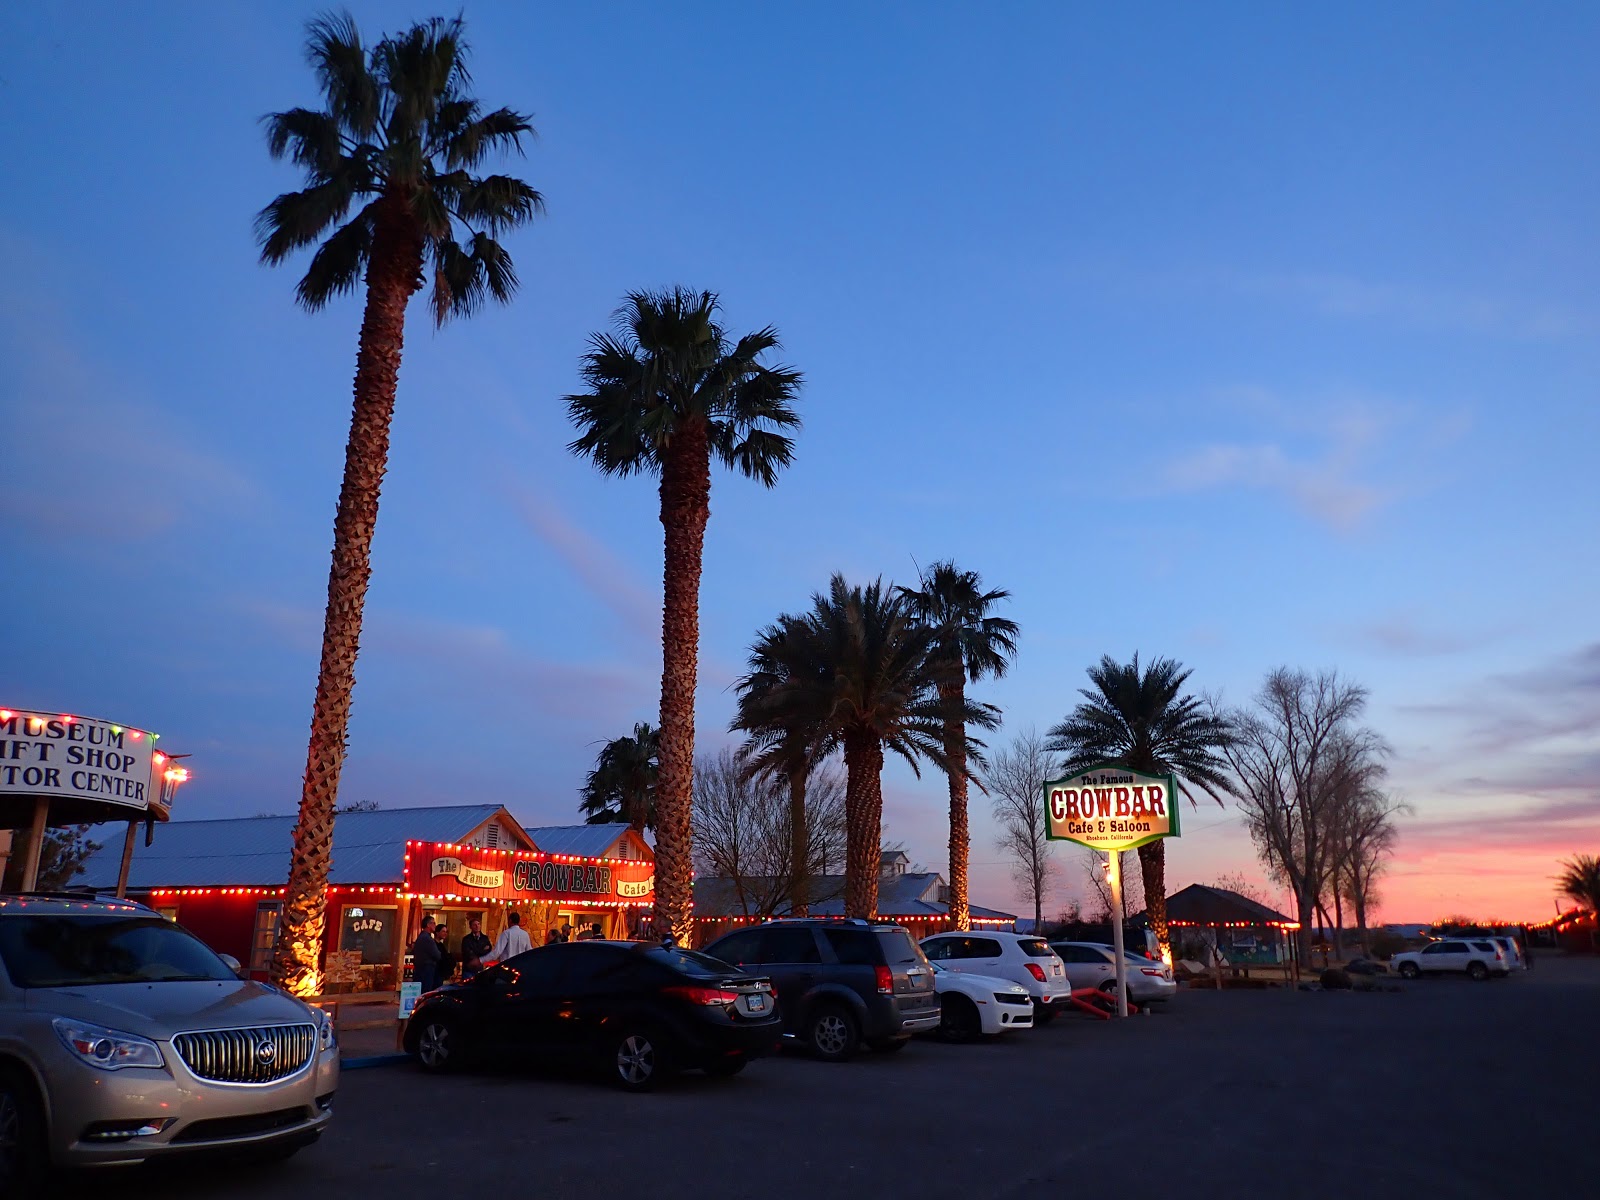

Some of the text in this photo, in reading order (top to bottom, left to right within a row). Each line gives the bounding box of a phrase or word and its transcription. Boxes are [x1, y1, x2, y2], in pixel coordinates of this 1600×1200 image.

[0, 716, 125, 750] MUSEUM
[66, 745, 135, 773] SHOP
[0, 765, 145, 801] TOR CENTER
[1081, 775, 1134, 786] The Famous
[1050, 785, 1166, 820] CROWBAR
[1068, 820, 1151, 834] Cafe & Saloon
[438, 860, 499, 886] The Famous
[512, 860, 612, 894] CROWBAR
[624, 883, 647, 895] Cafe
[353, 918, 383, 932] CAFE
